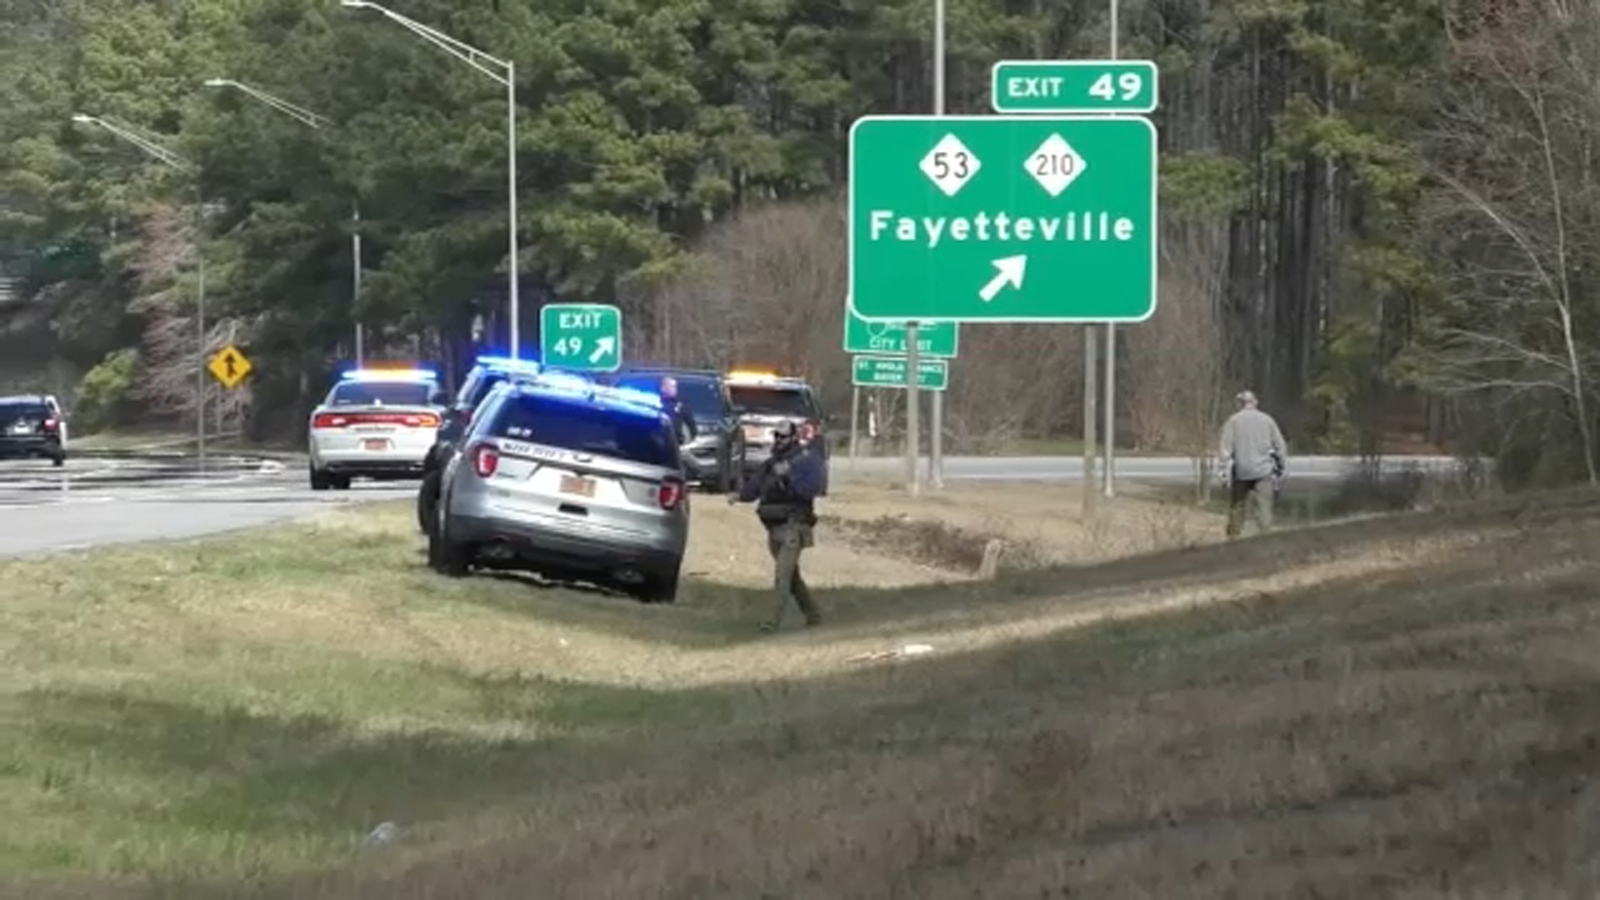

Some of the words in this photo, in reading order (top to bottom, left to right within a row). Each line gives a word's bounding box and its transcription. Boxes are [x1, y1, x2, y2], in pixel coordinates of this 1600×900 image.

[1007, 76, 1064, 98] EXIT
[1088, 72, 1142, 100] 49
[933, 151, 969, 179] 53
[1036, 153, 1074, 176] 210
[869, 210, 1135, 248] Fayetteville
[559, 312, 601, 329] EXIT
[554, 337, 582, 356] 49
